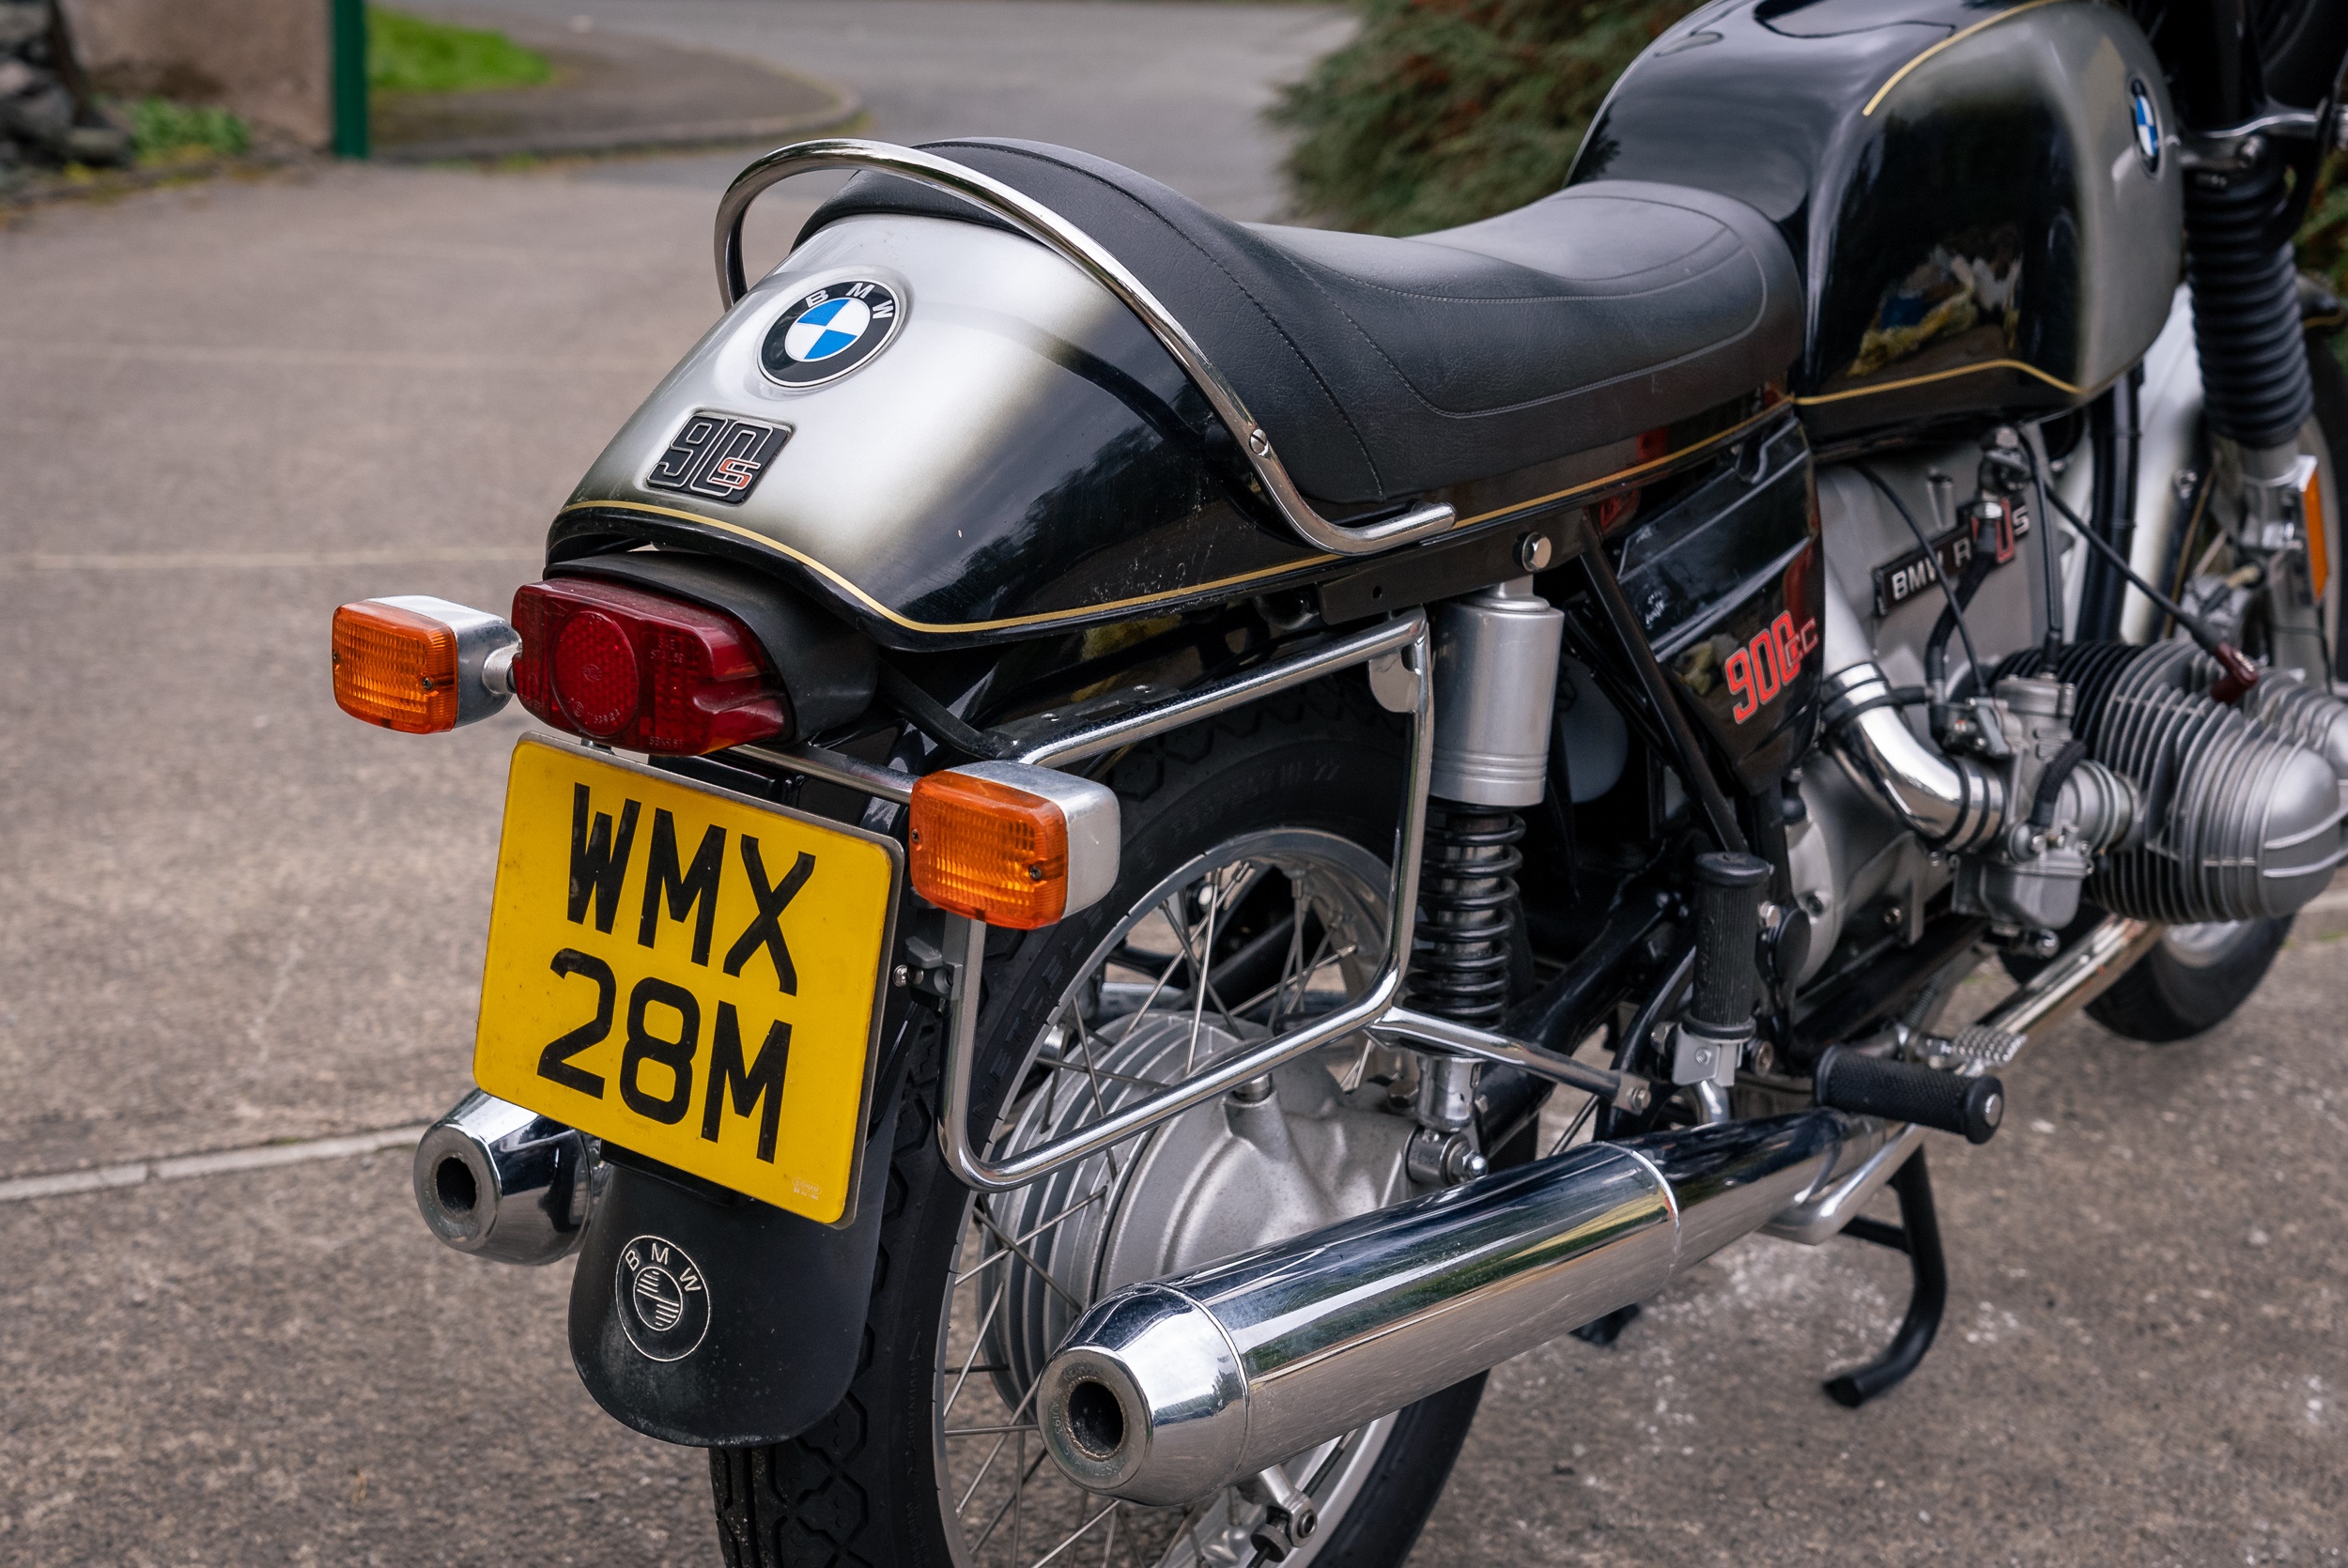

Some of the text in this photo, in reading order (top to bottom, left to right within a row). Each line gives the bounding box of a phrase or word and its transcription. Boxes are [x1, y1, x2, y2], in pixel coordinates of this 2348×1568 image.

[805, 282, 894, 320] BMW
[1892, 550, 1943, 601] BMW
[566, 782, 816, 997] WMX
[536, 947, 793, 1165] 28M
[625, 1242, 702, 1292] BMW
